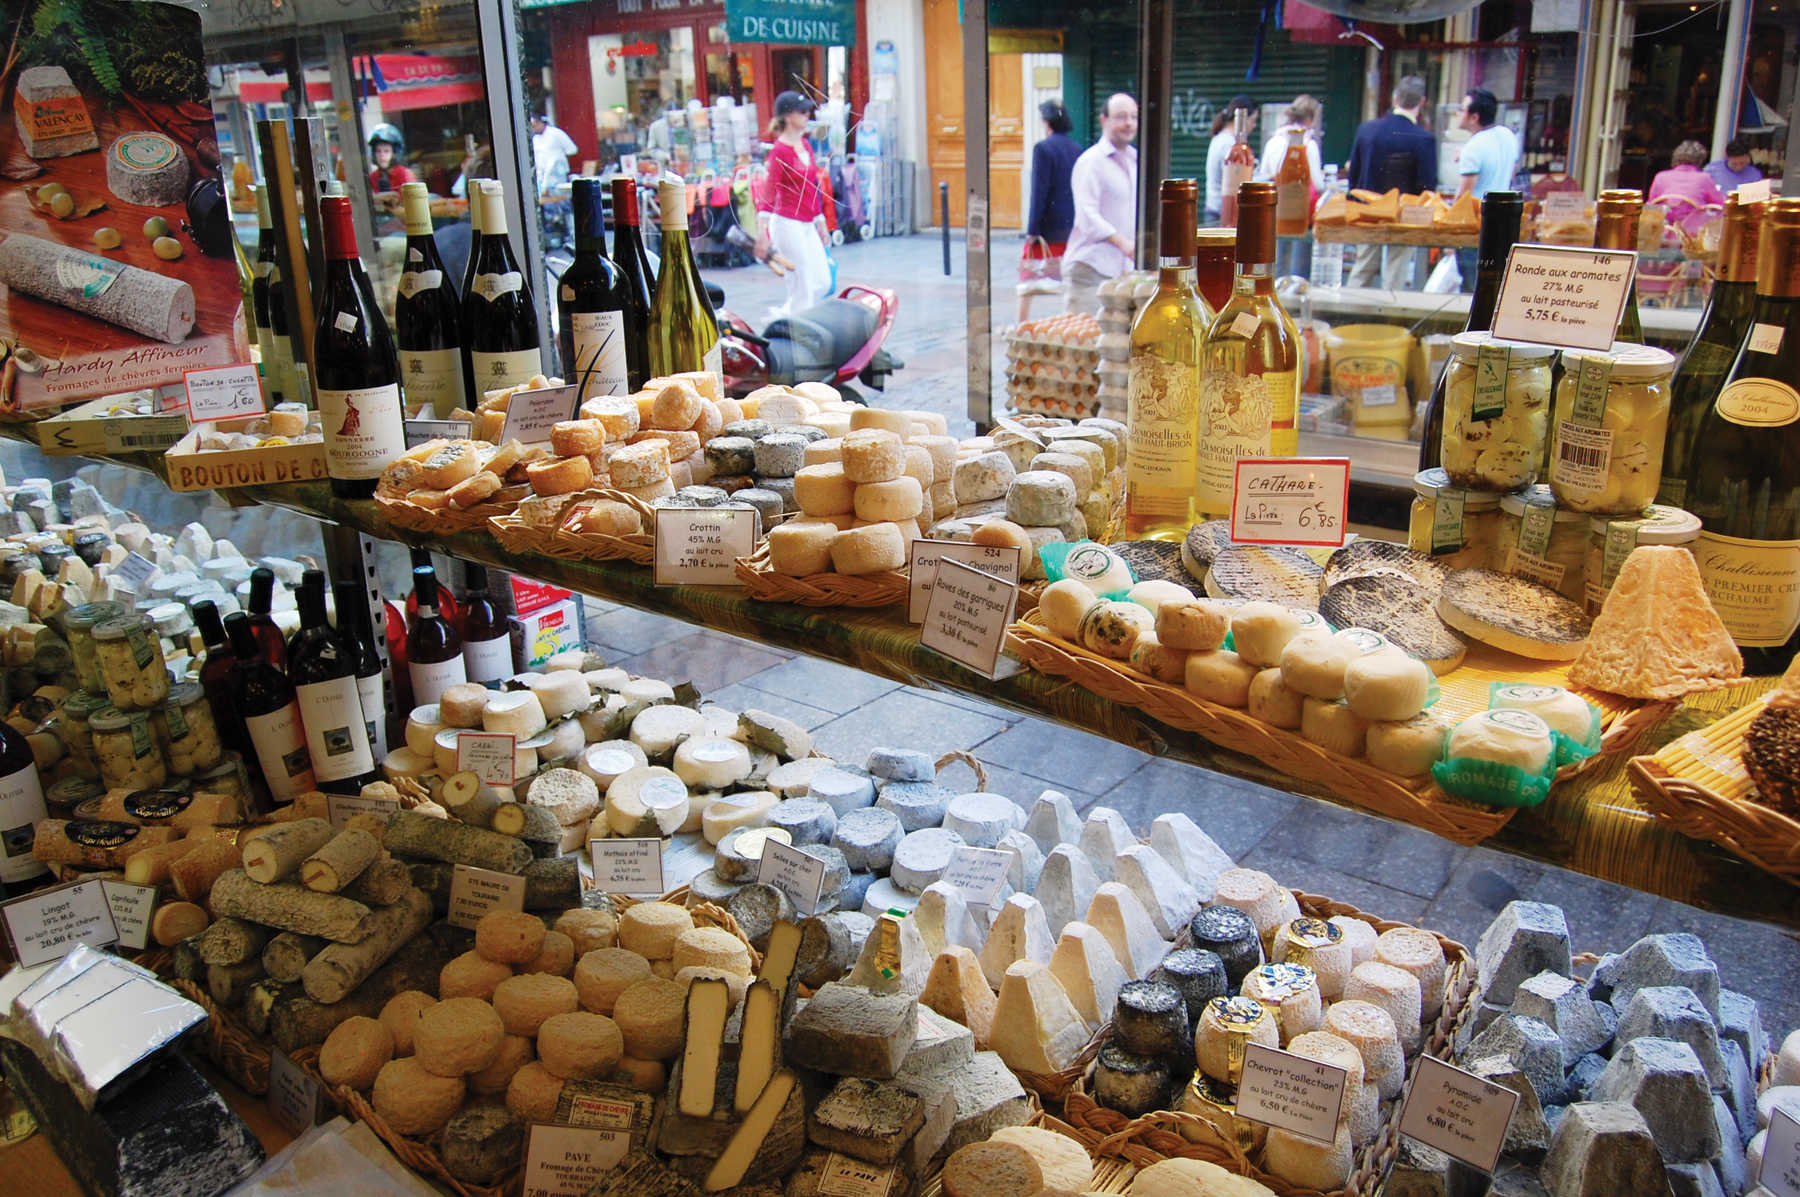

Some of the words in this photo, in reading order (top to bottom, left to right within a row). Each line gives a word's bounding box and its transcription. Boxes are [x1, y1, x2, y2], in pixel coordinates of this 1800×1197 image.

[743, 15, 768, 38] DE
[772, 17, 841, 42] CUISINE
[1593, 254, 1612, 265] 146
[1514, 264, 1546, 276] Ronde
[1549, 268, 1567, 278] aux
[1570, 270, 1623, 282] aromates
[1542, 281, 1563, 293] 27%
[1520, 295, 1531, 304] au
[1533, 294, 1548, 305] lait
[1550, 297, 1600, 310] pasteurisé
[1525, 308, 1550, 321] 5,75
[1551, 311, 1561, 322] €
[41, 356, 114, 379] Hardy
[121, 343, 209, 368] Affineur
[46, 379, 100, 393] Fromages
[104, 375, 117, 384] de
[1739, 403, 1770, 415] 2004
[328, 447, 389, 459] BOURGOGNE
[180, 461, 267, 488] BOUTON
[275, 458, 302, 481] DE
[689, 523, 721, 532] Crottin
[983, 548, 1001, 557] 524
[679, 558, 699, 569] 2,70
[700, 559, 707, 568] €
[921, 582, 932, 590] au
[1713, 579, 1772, 593] PREMIER
[956, 586, 970, 599] des
[970, 591, 1005, 613] garrigues
[1710, 589, 1769, 605] RCHAUME
[1448, 771, 1518, 792] ROMAGE
[72, 886, 83, 896] 55
[41, 901, 71, 916] Lingot
[1247, 1059, 1284, 1076] Chevrot
[1286, 1069, 1339, 1092] "collection"
[540, 1161, 574, 1173] Fromage
[575, 1164, 584, 1172] de
